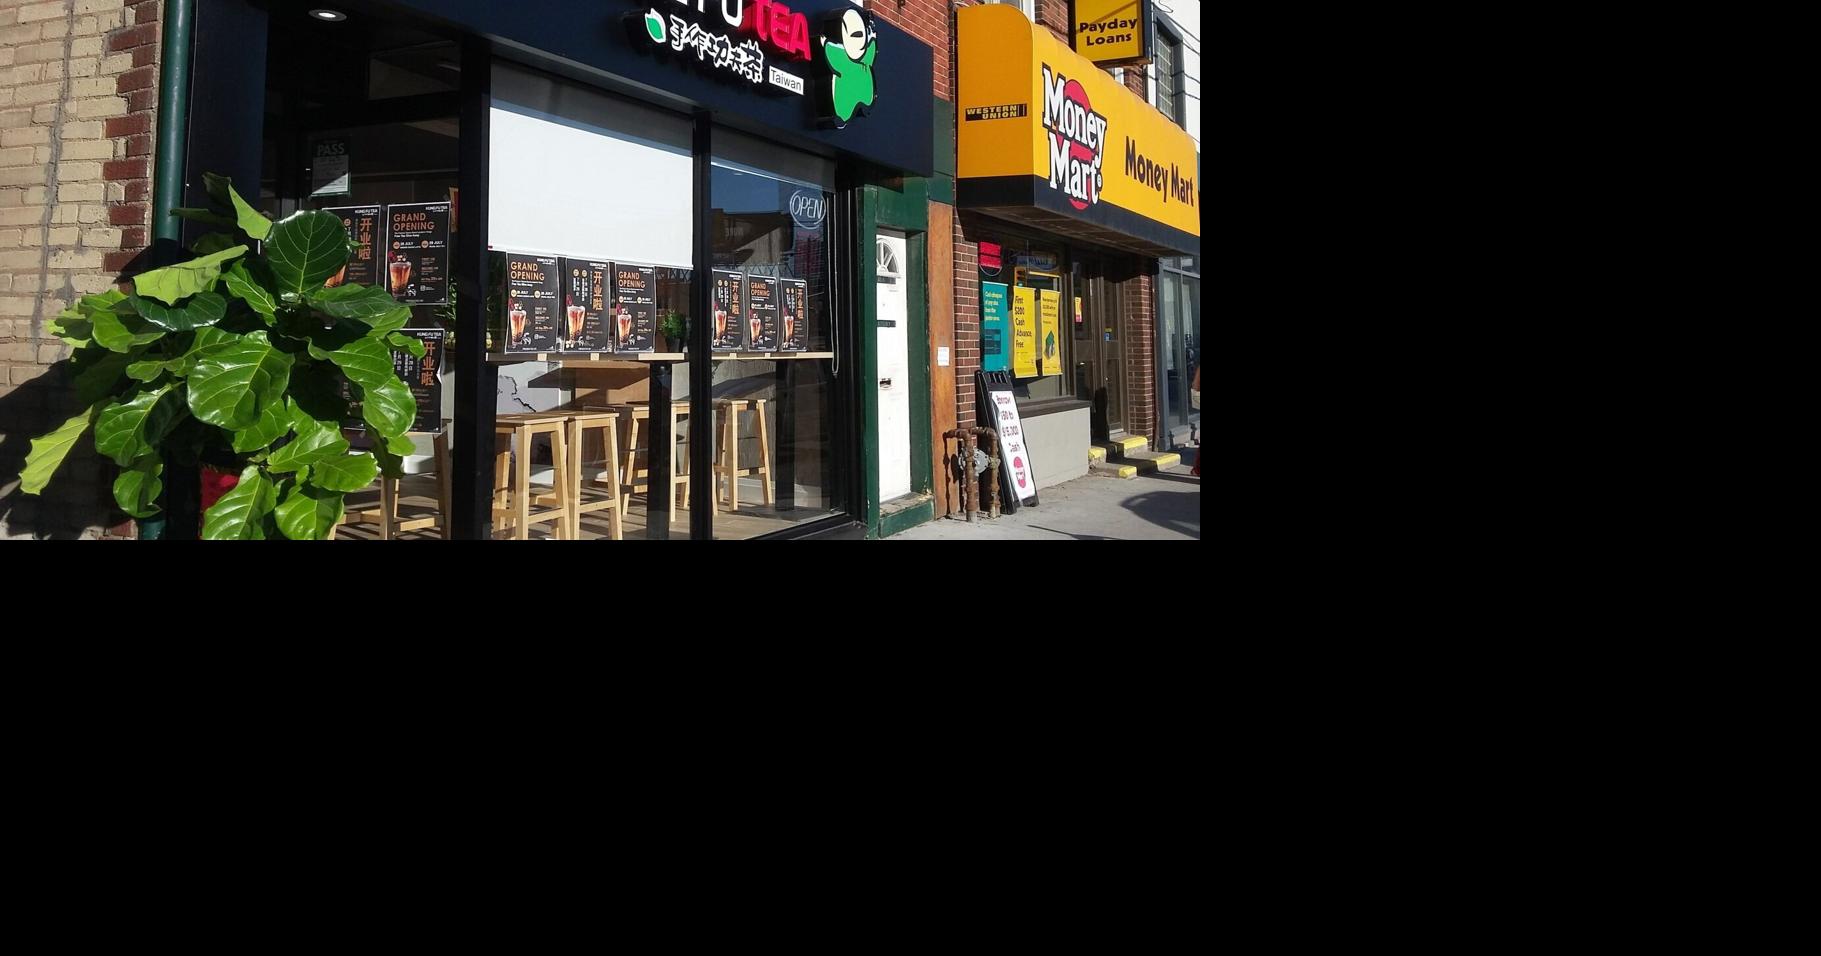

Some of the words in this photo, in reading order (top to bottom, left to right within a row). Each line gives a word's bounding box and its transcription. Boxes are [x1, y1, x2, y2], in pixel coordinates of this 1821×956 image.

[756, 0, 811, 61] TEA
[1079, 17, 1138, 34] Payday
[1086, 33, 1132, 46] Loans
[670, 14, 764, 83] 手作功夫茶
[770, 69, 802, 92] Taiwan
[967, 105, 1017, 115] WESTERN
[982, 111, 1017, 119] UNION
[1042, 63, 1107, 167] Money
[317, 143, 345, 156] PASS
[1049, 131, 1100, 205] Mart
[1125, 136, 1168, 203] Money
[1171, 162, 1194, 207] Mart
[792, 194, 824, 219] OPEN
[393, 212, 426, 222] GRAND
[393, 222, 435, 231] OPENING
[511, 261, 537, 271] GRAND
[511, 271, 545, 281] OPENING
[618, 271, 640, 280] GRAND
[618, 279, 646, 288] OPENING
[750, 289, 771, 297] OPENING
